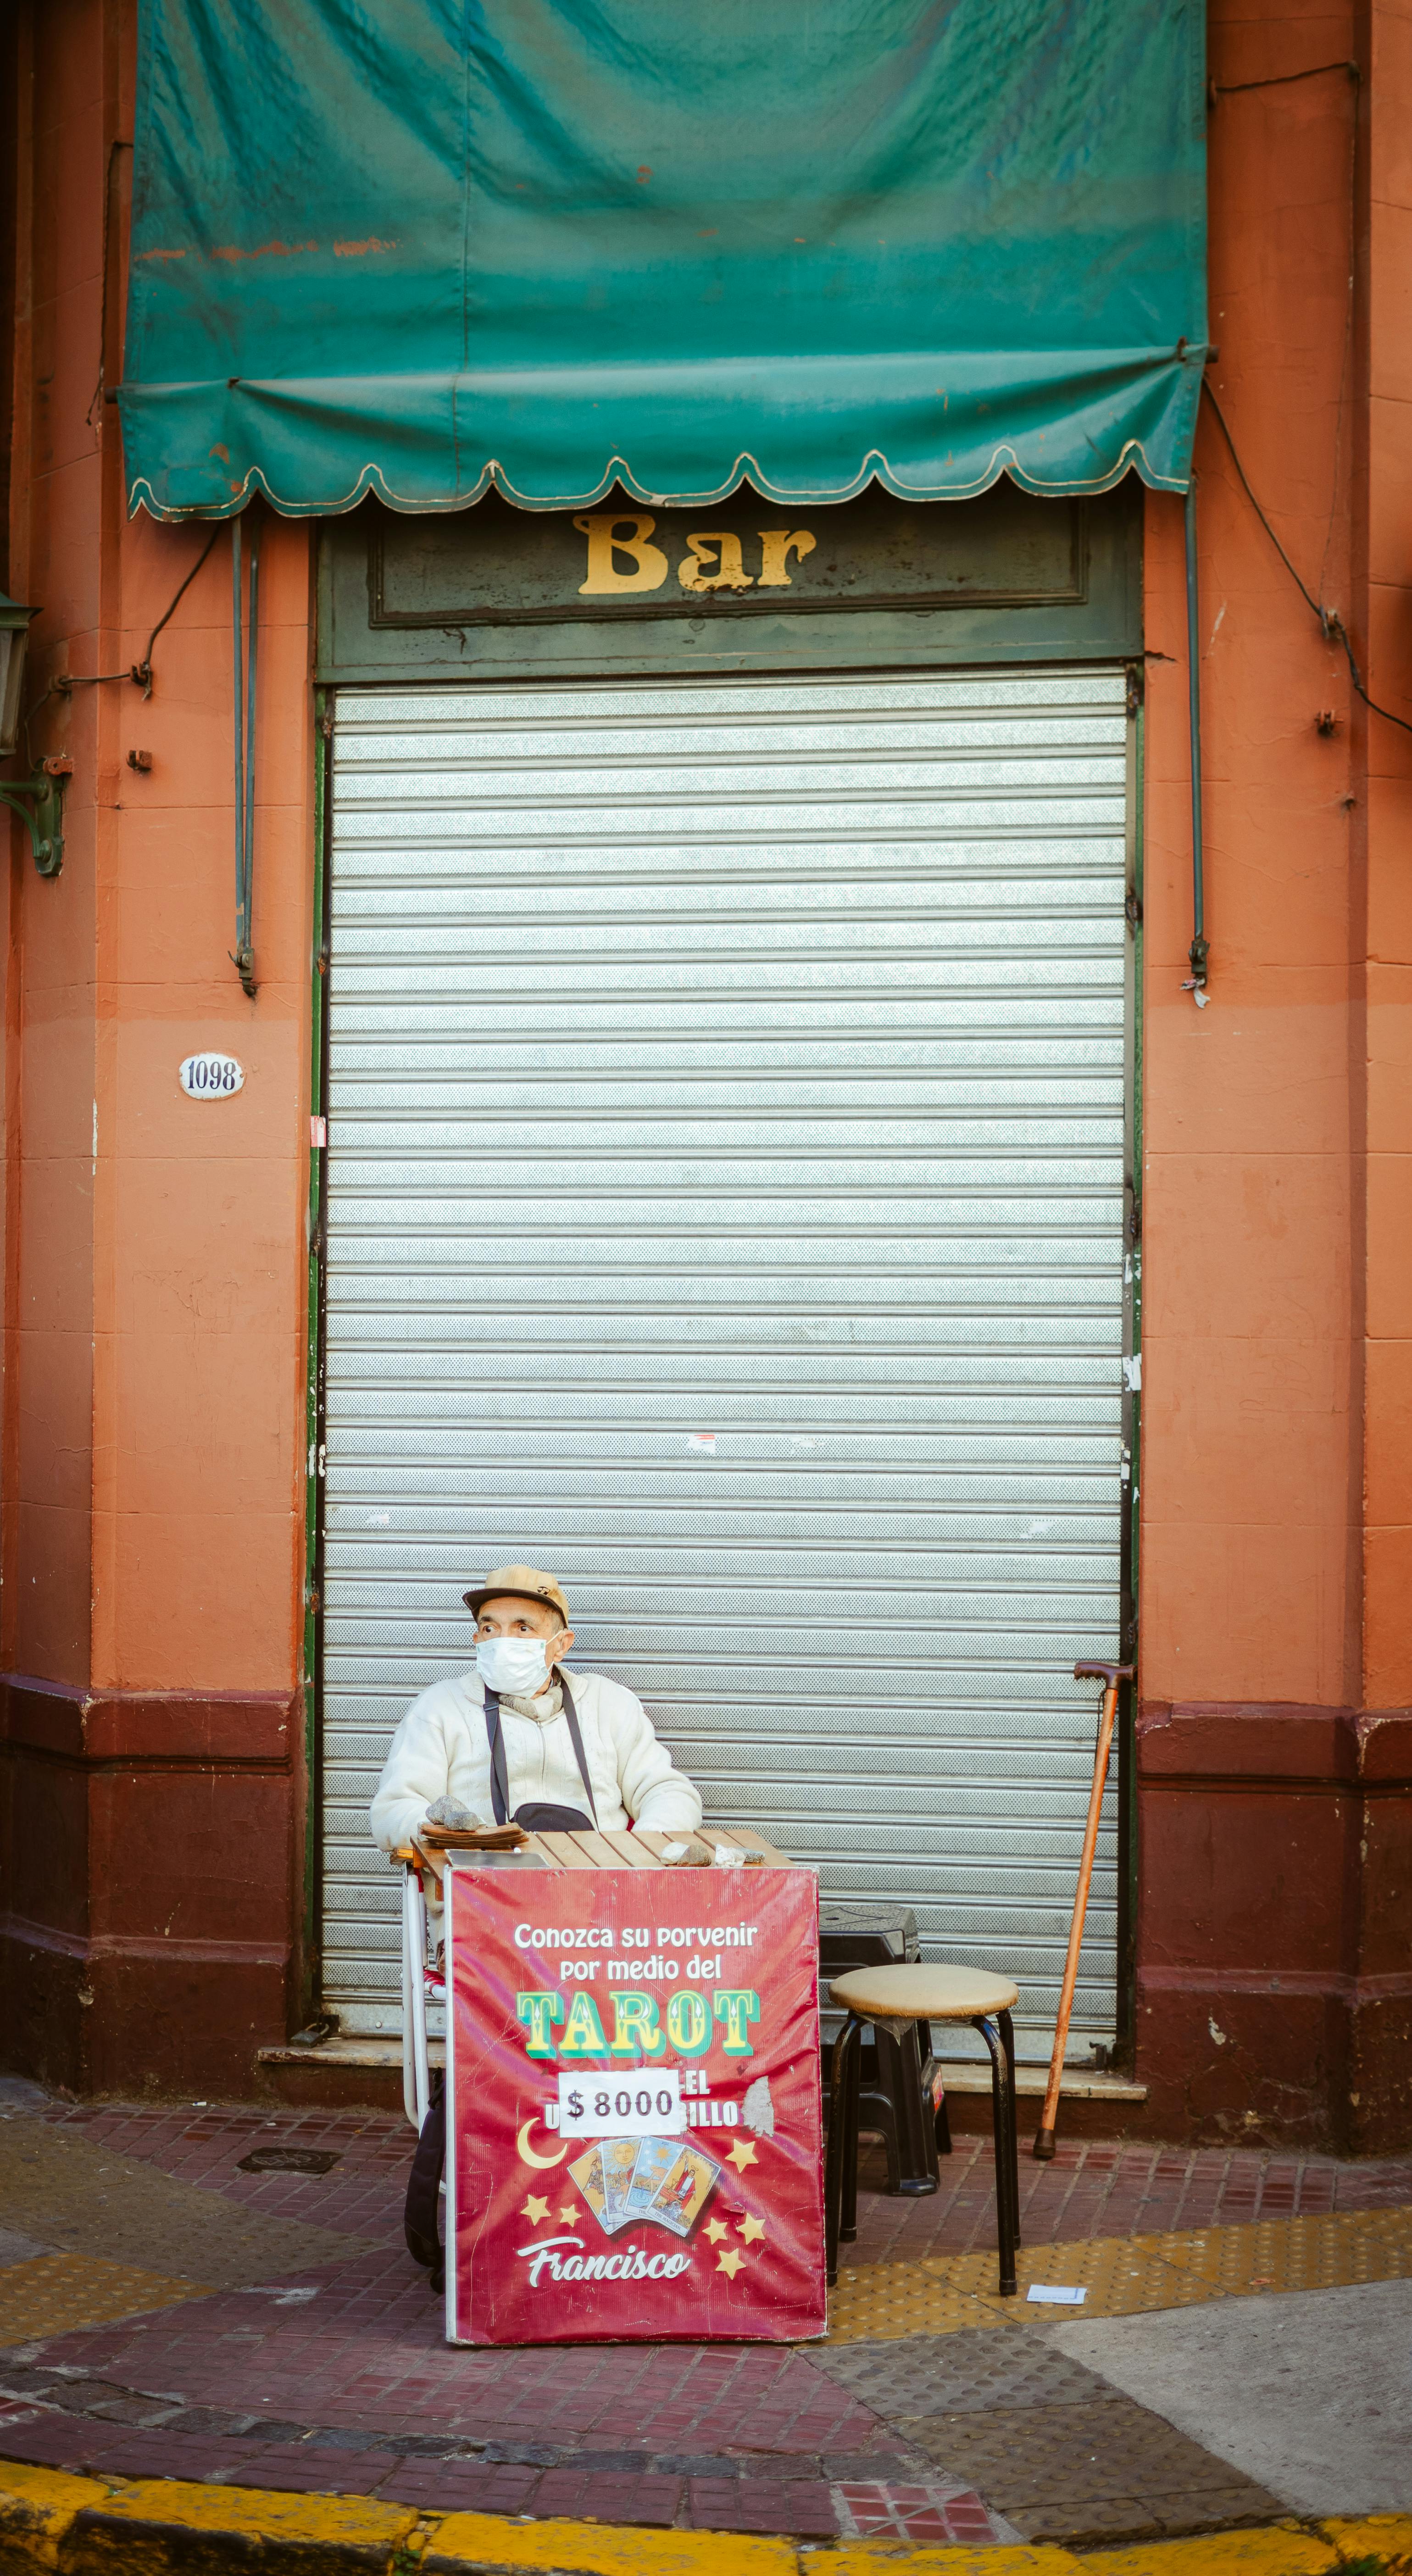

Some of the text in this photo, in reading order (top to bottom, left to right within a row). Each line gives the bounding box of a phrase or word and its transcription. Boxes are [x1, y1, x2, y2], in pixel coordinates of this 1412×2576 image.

[573, 514, 817, 594] Bar
[188, 1060, 235, 1090] 1098
[515, 1922, 758, 1948] Conozca su porvenir
[561, 1954, 722, 1980] por medio del
[517, 1989, 761, 2059] TAROT
[594, 2089, 673, 2117] 8000
[662, 2216, 681, 2230] MAGICIAN
[517, 2236, 691, 2288] Francisco
